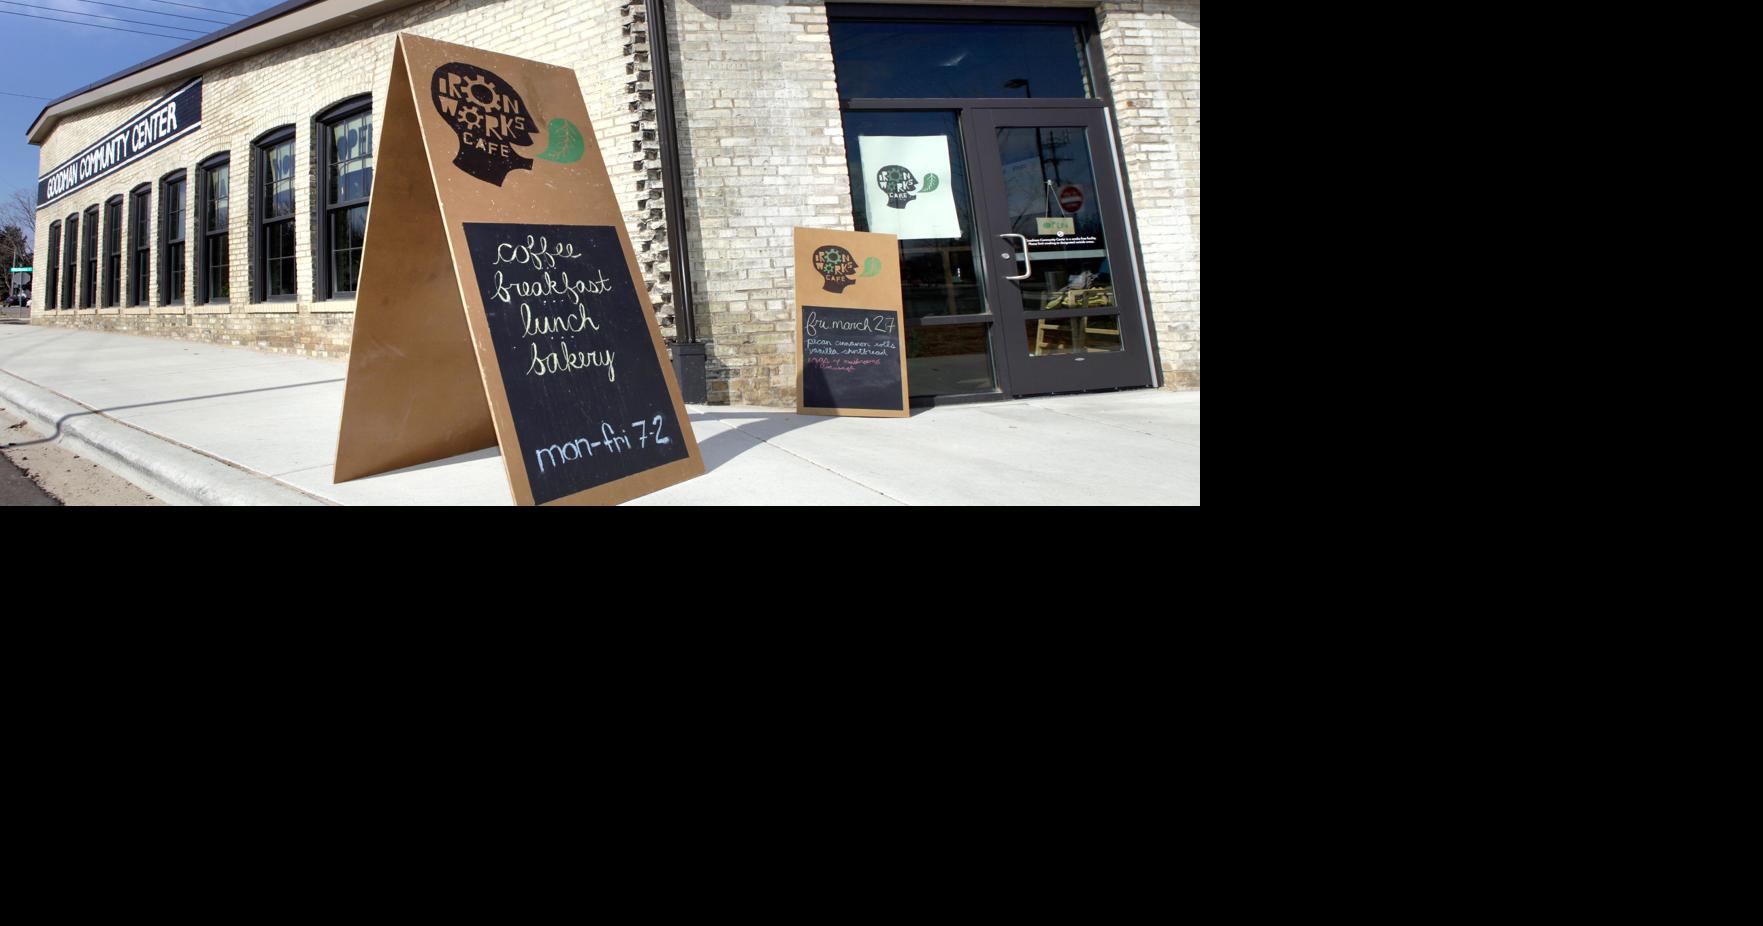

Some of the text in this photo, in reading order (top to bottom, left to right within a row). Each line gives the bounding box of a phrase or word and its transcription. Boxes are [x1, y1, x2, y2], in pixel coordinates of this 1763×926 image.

[439, 73, 518, 114] IRON
[439, 95, 525, 140] WORKS
[47, 102, 177, 199] GOODMAN COMMUNITY CENTER
[463, 132, 509, 158] CAFE
[879, 168, 910, 182] IRON
[880, 180, 913, 193] WORKS
[493, 235, 582, 269] coffee
[815, 249, 849, 265] IRON
[815, 262, 853, 275] WORKS
[491, 270, 612, 304] breakfast
[520, 303, 600, 338] lunch
[832, 318, 872, 332] march
[873, 315, 895, 333] 27
[527, 342, 615, 382] bakery
[536, 415, 669, 472] mon-fri 7-2
